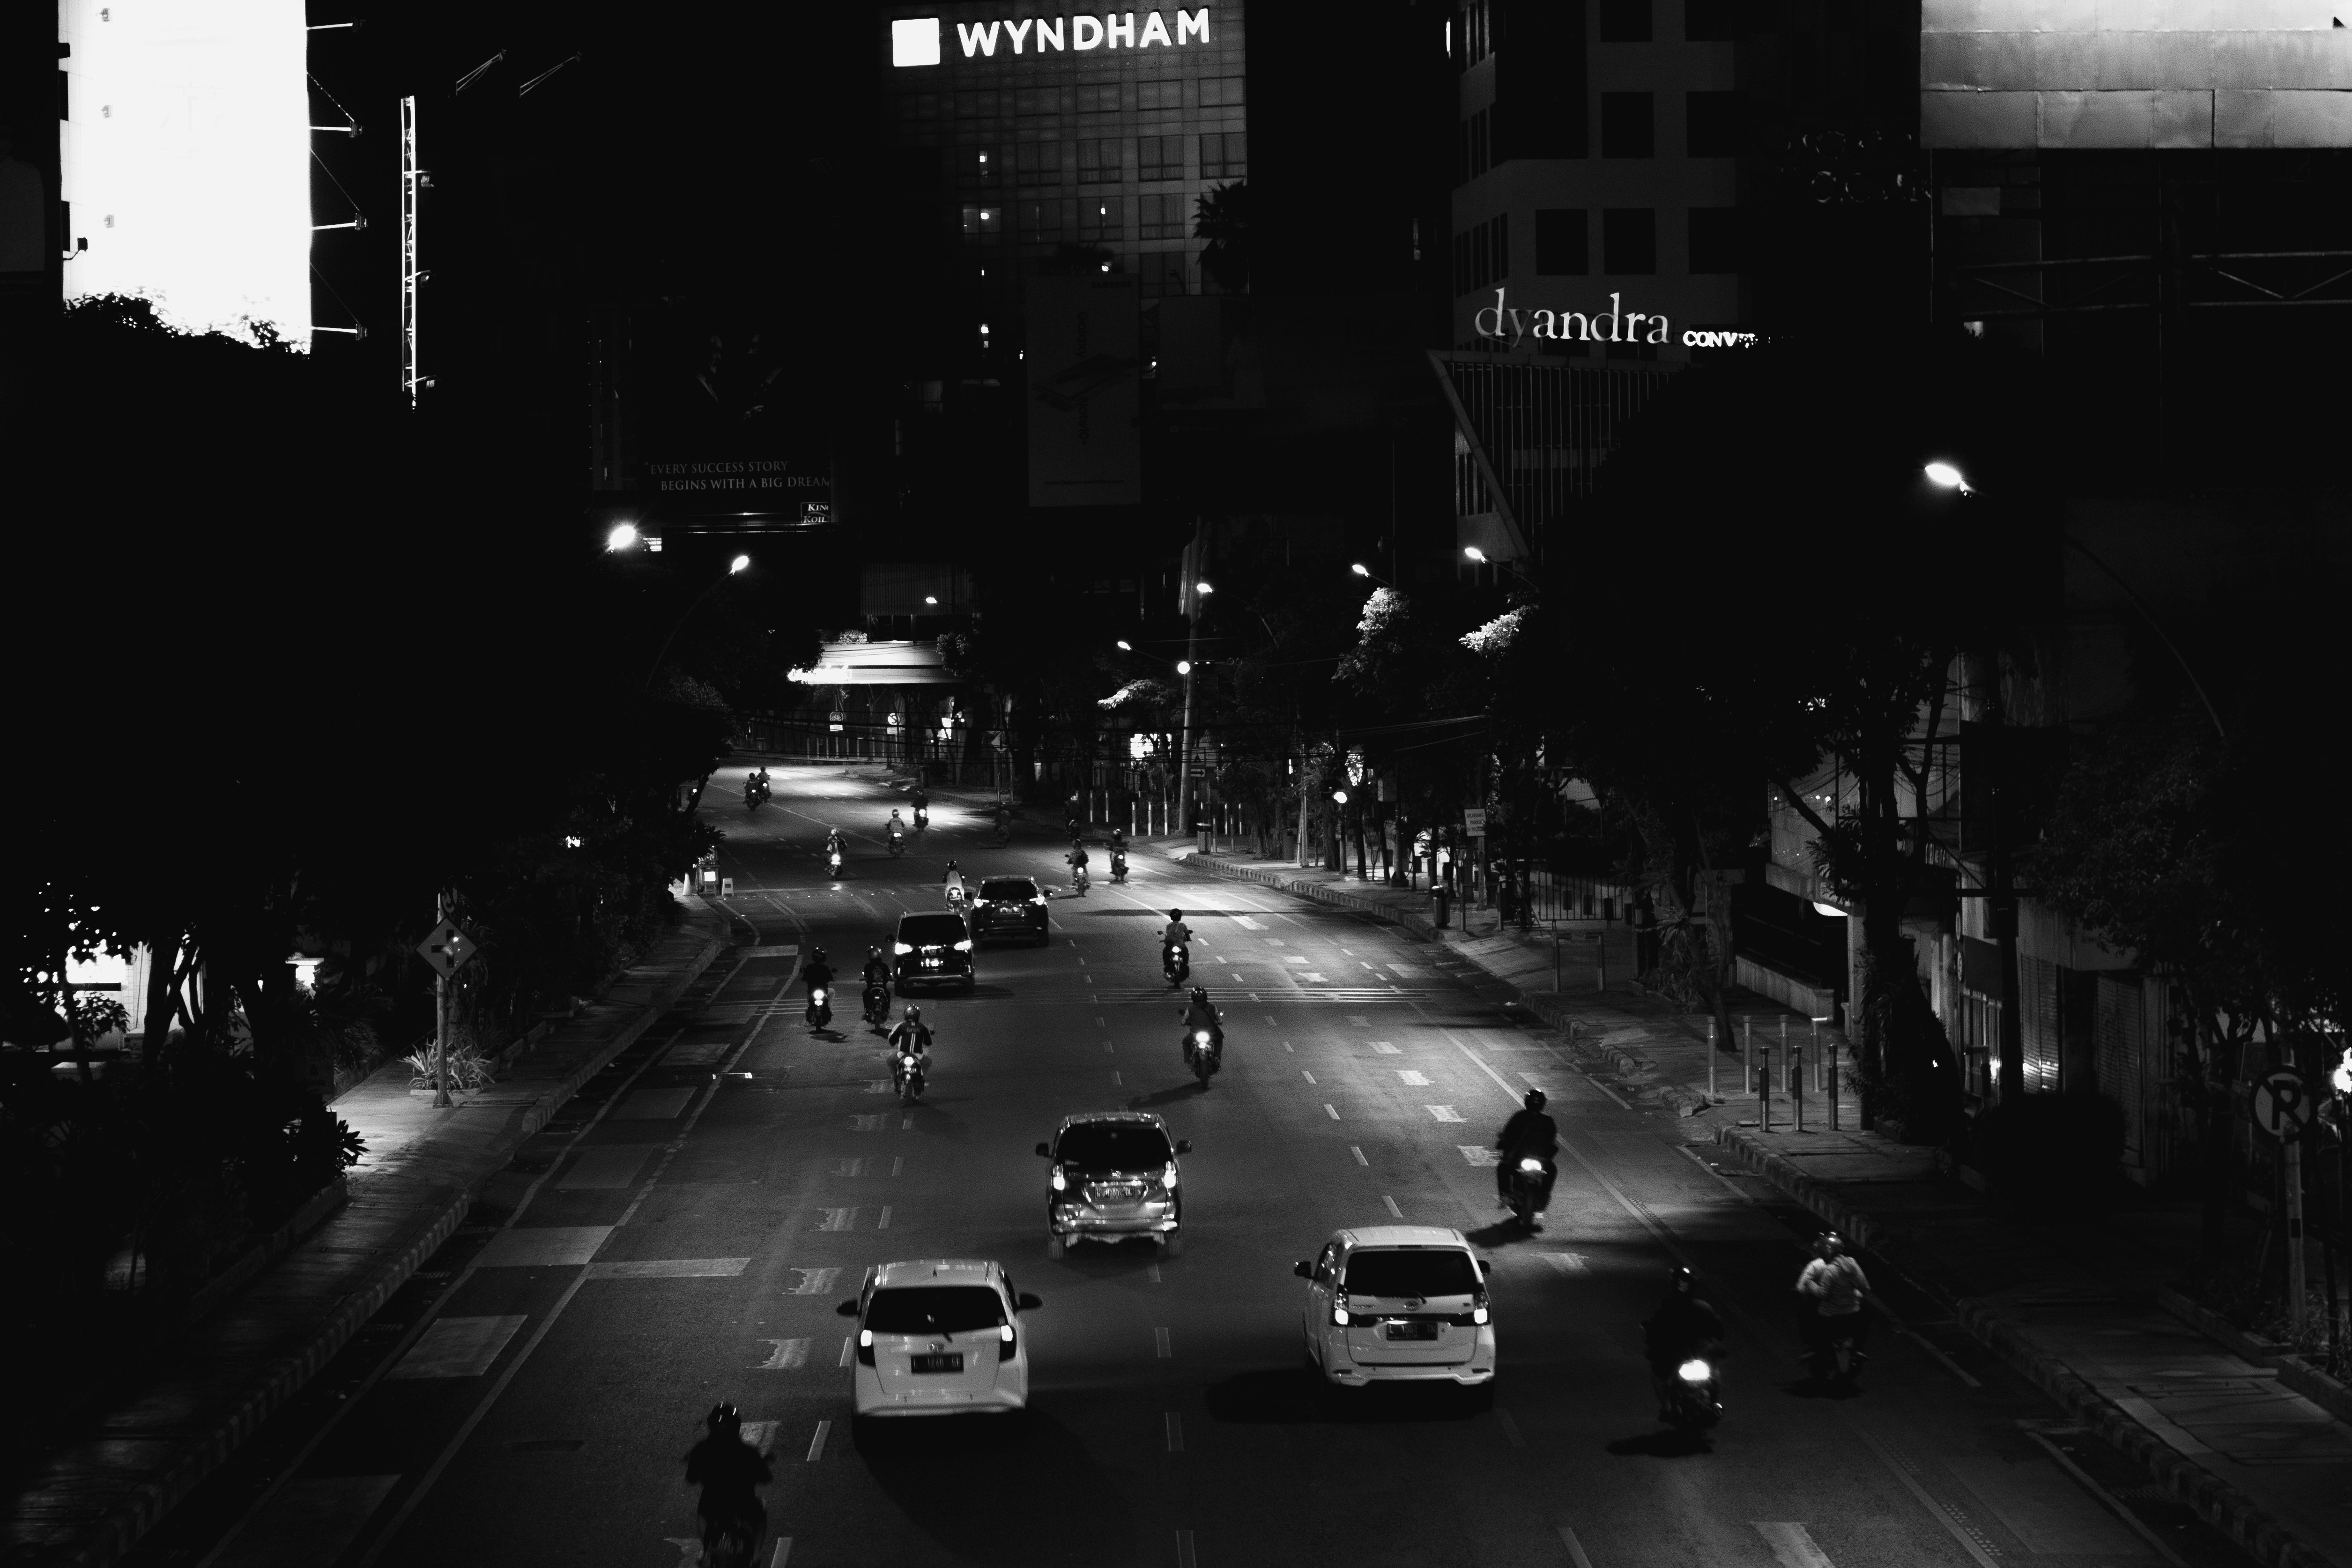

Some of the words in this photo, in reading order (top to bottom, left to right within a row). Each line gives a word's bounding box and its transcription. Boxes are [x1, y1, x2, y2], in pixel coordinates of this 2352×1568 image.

[957, 7, 1210, 57] WYNDHAM
[1475, 287, 1671, 349] dyandra
[1683, 330, 1758, 349] CONV
[691, 461, 744, 474] SUCCESS
[748, 460, 788, 472] STORY
[660, 479, 707, 491] BEGINS
[710, 478, 745, 490] WITH
[749, 478, 757, 489] A
[761, 477, 783, 488] BIG
[787, 476, 830, 488] DREAM
